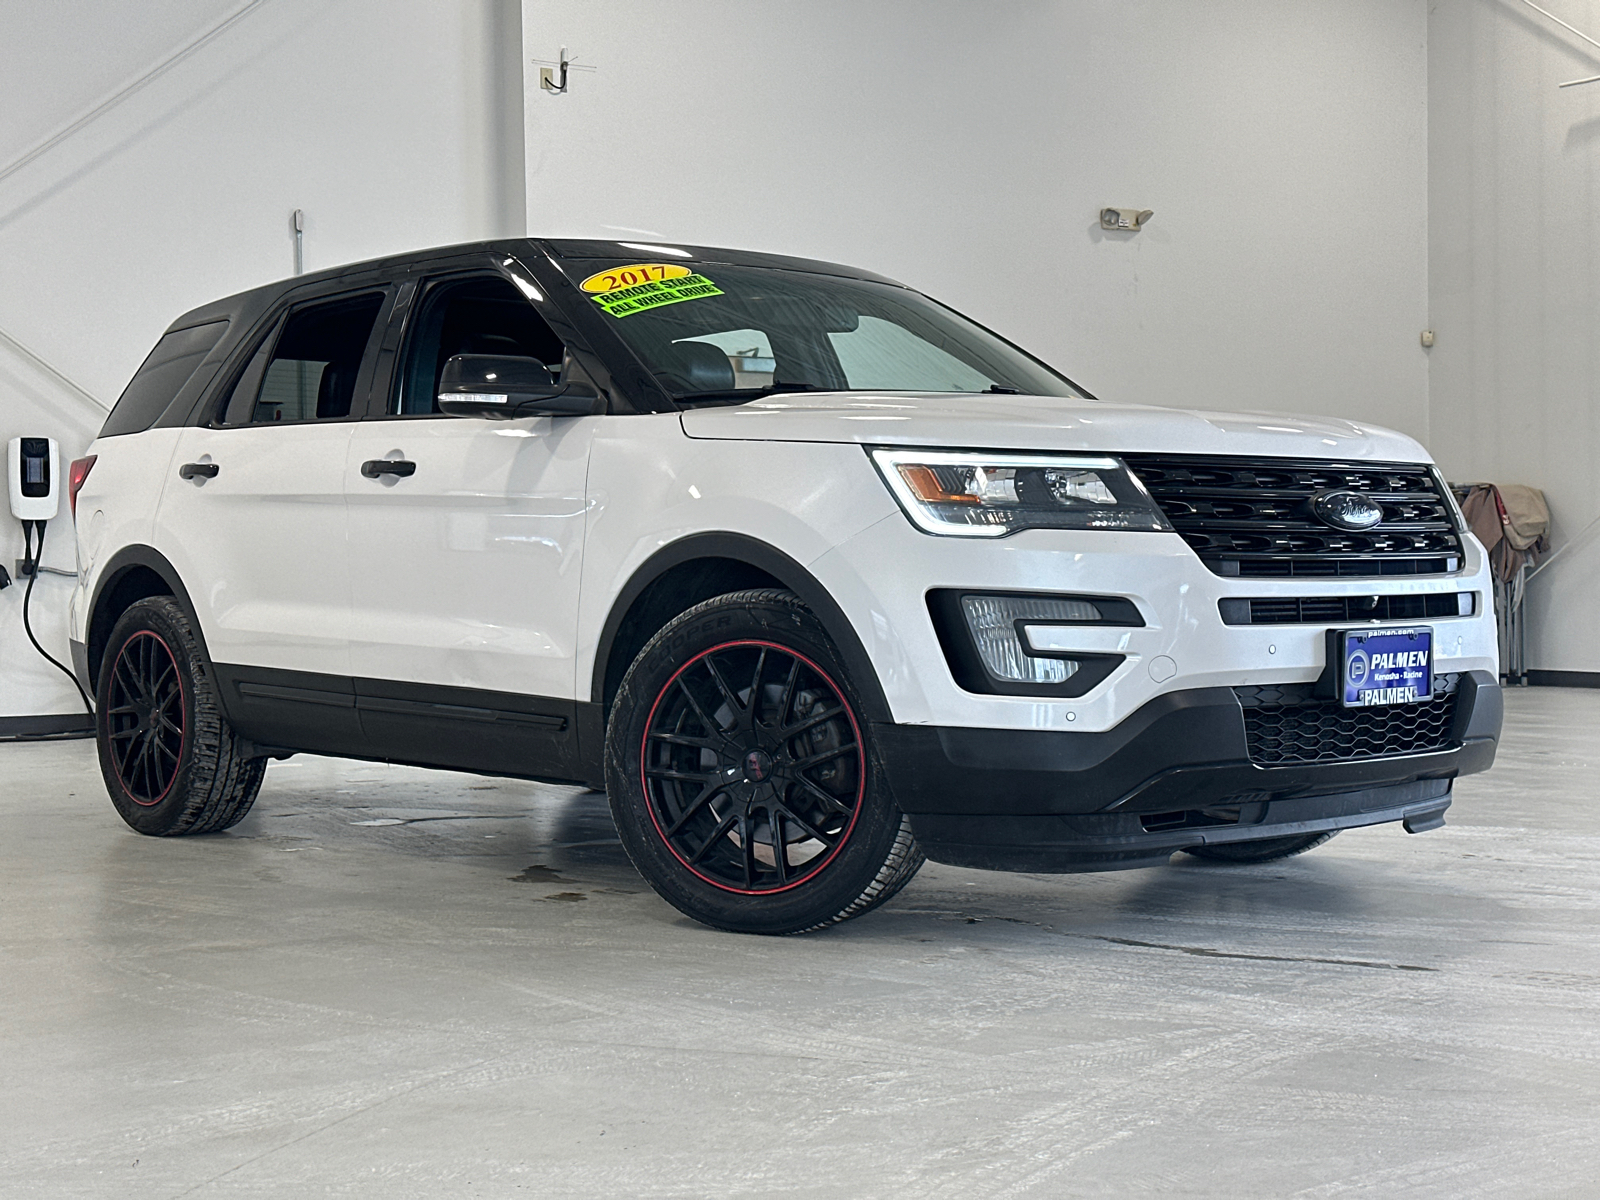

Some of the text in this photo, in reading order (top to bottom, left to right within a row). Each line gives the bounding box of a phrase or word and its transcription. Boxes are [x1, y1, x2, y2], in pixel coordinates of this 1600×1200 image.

[602, 266, 665, 290] 2017
[600, 276, 702, 304] REMOTE START
[610, 284, 714, 315] ALL WHEEL DRIVE
[1368, 629, 1414, 638] palmen.com
[1371, 650, 1428, 670] PALMEN
[1374, 671, 1423, 681] Kenosha Racine
[1364, 687, 1413, 706] PALMEN
